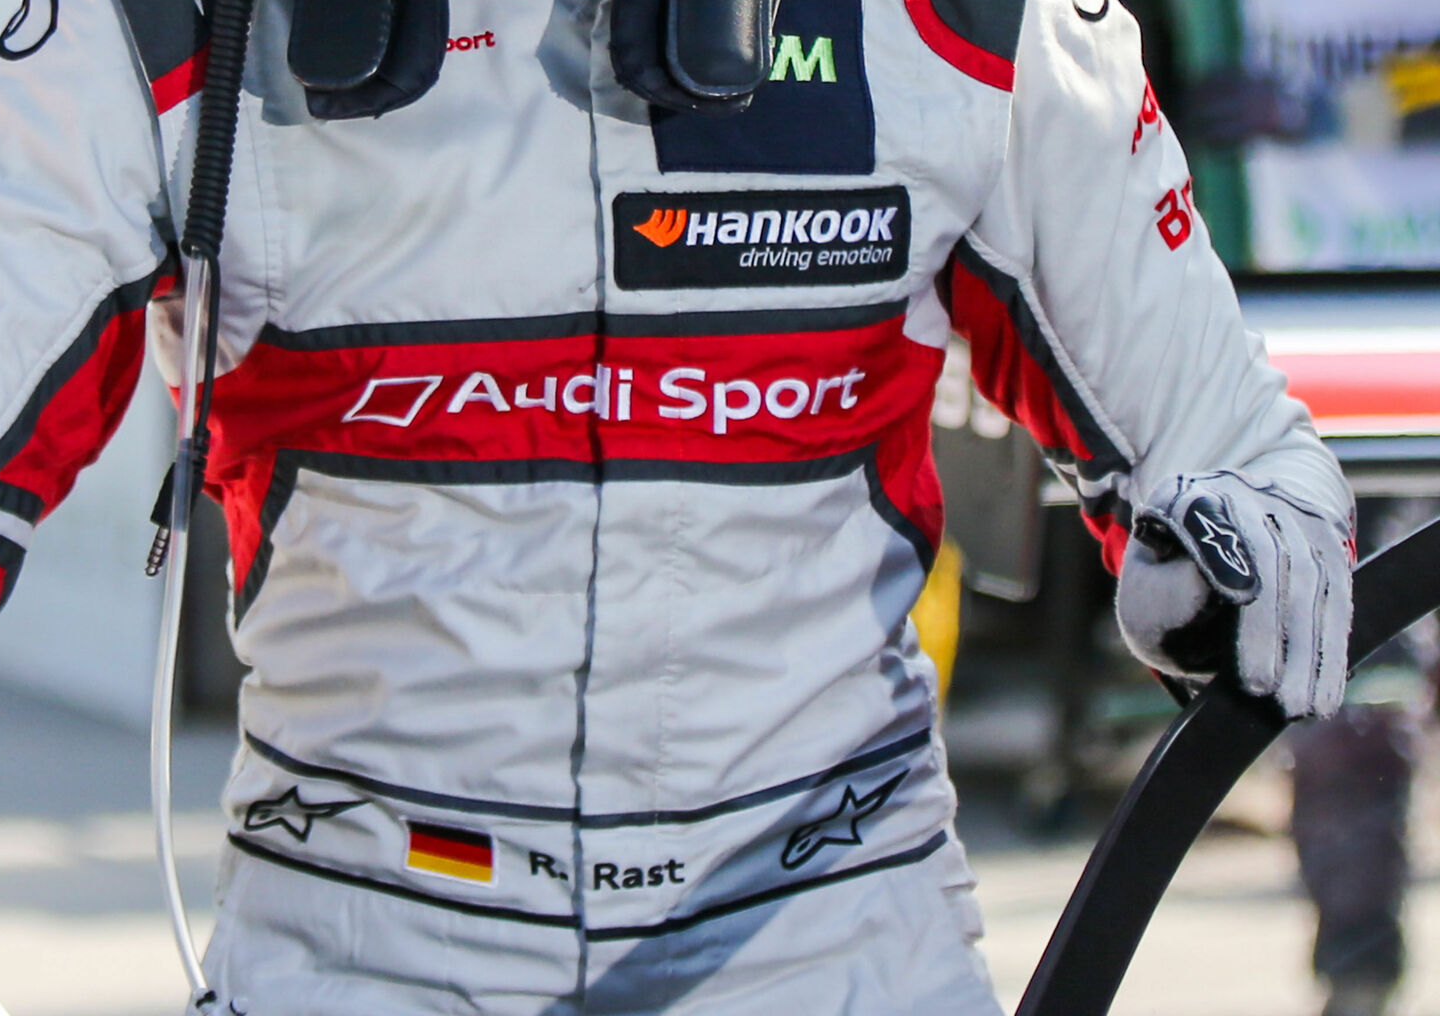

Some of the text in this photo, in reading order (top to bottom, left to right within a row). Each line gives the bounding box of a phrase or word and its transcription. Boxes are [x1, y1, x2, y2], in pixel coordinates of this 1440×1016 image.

[739, 245, 893, 271] driving emotion
[447, 362, 866, 435] Audi Sport
[528, 850, 685, 891] R. Rast
